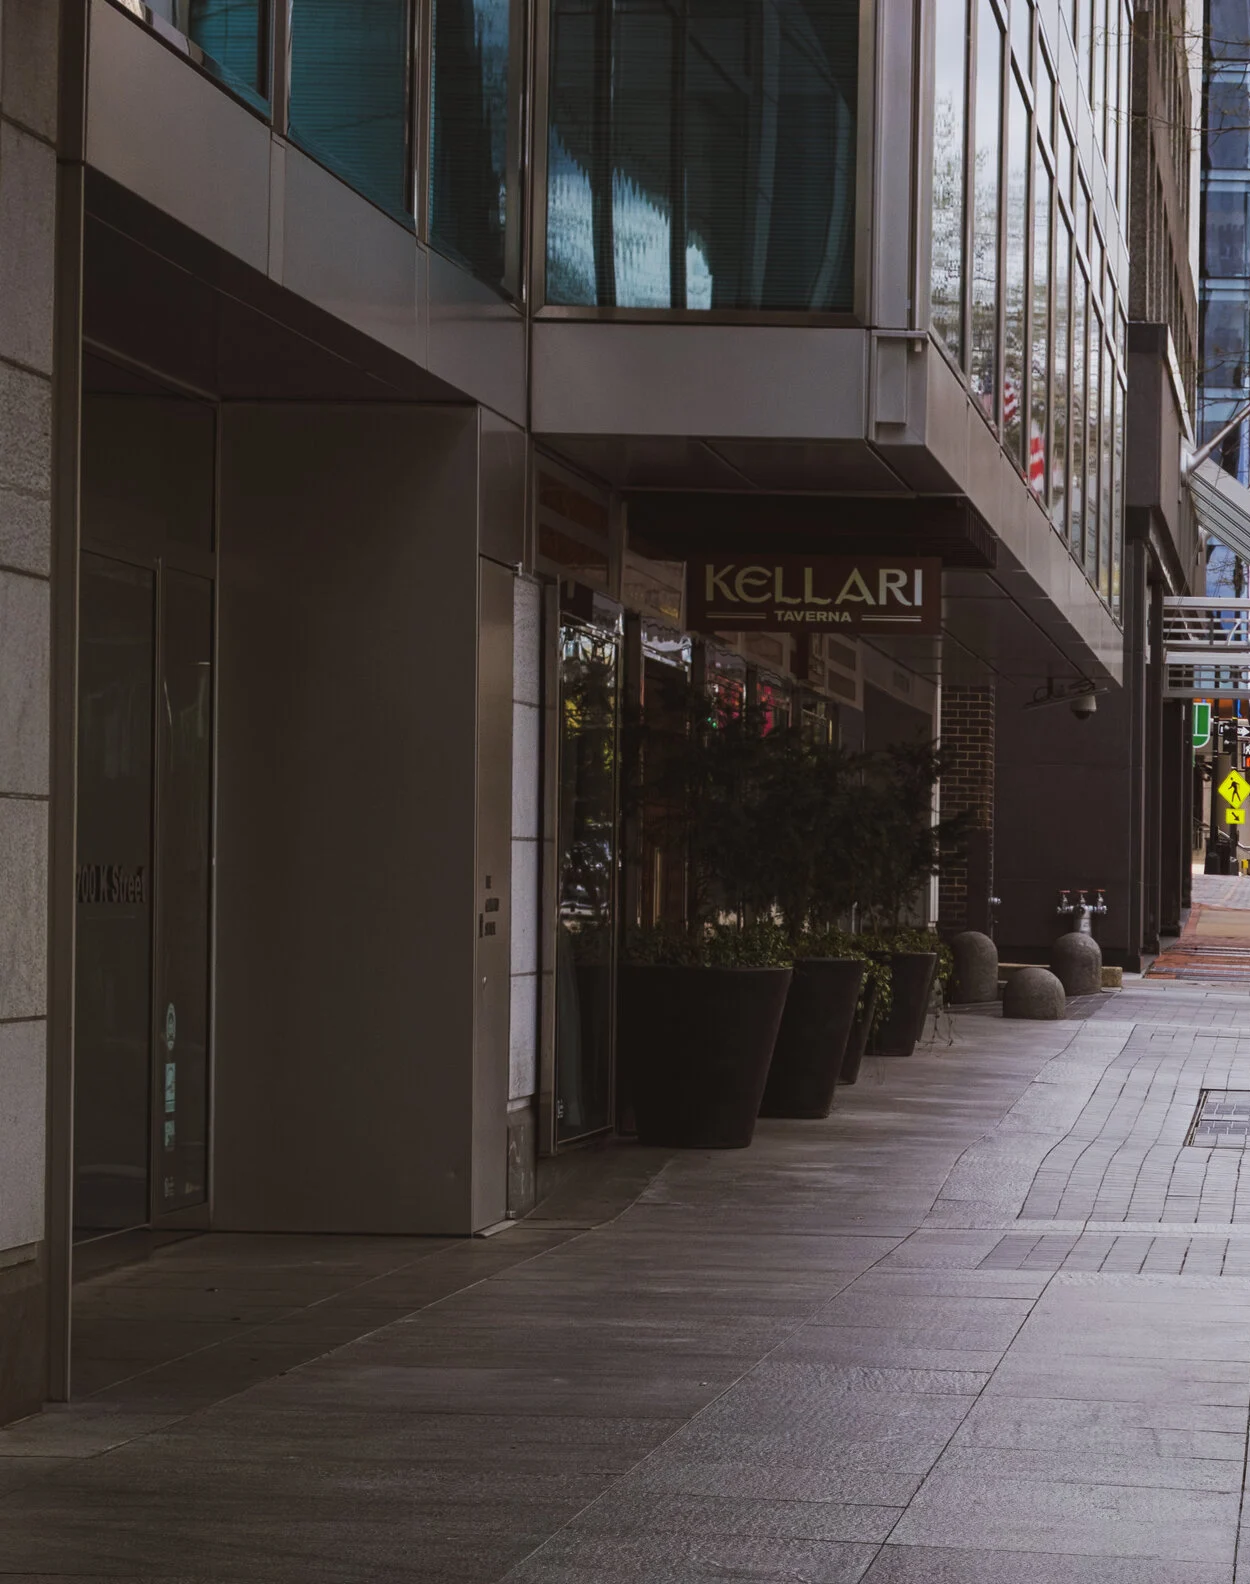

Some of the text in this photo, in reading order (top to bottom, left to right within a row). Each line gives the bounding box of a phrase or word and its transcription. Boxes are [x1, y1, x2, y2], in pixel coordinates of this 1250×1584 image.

[705, 563, 923, 607] KELLARI
[774, 610, 853, 623] TAVERNA
[112, 865, 147, 904] Street
